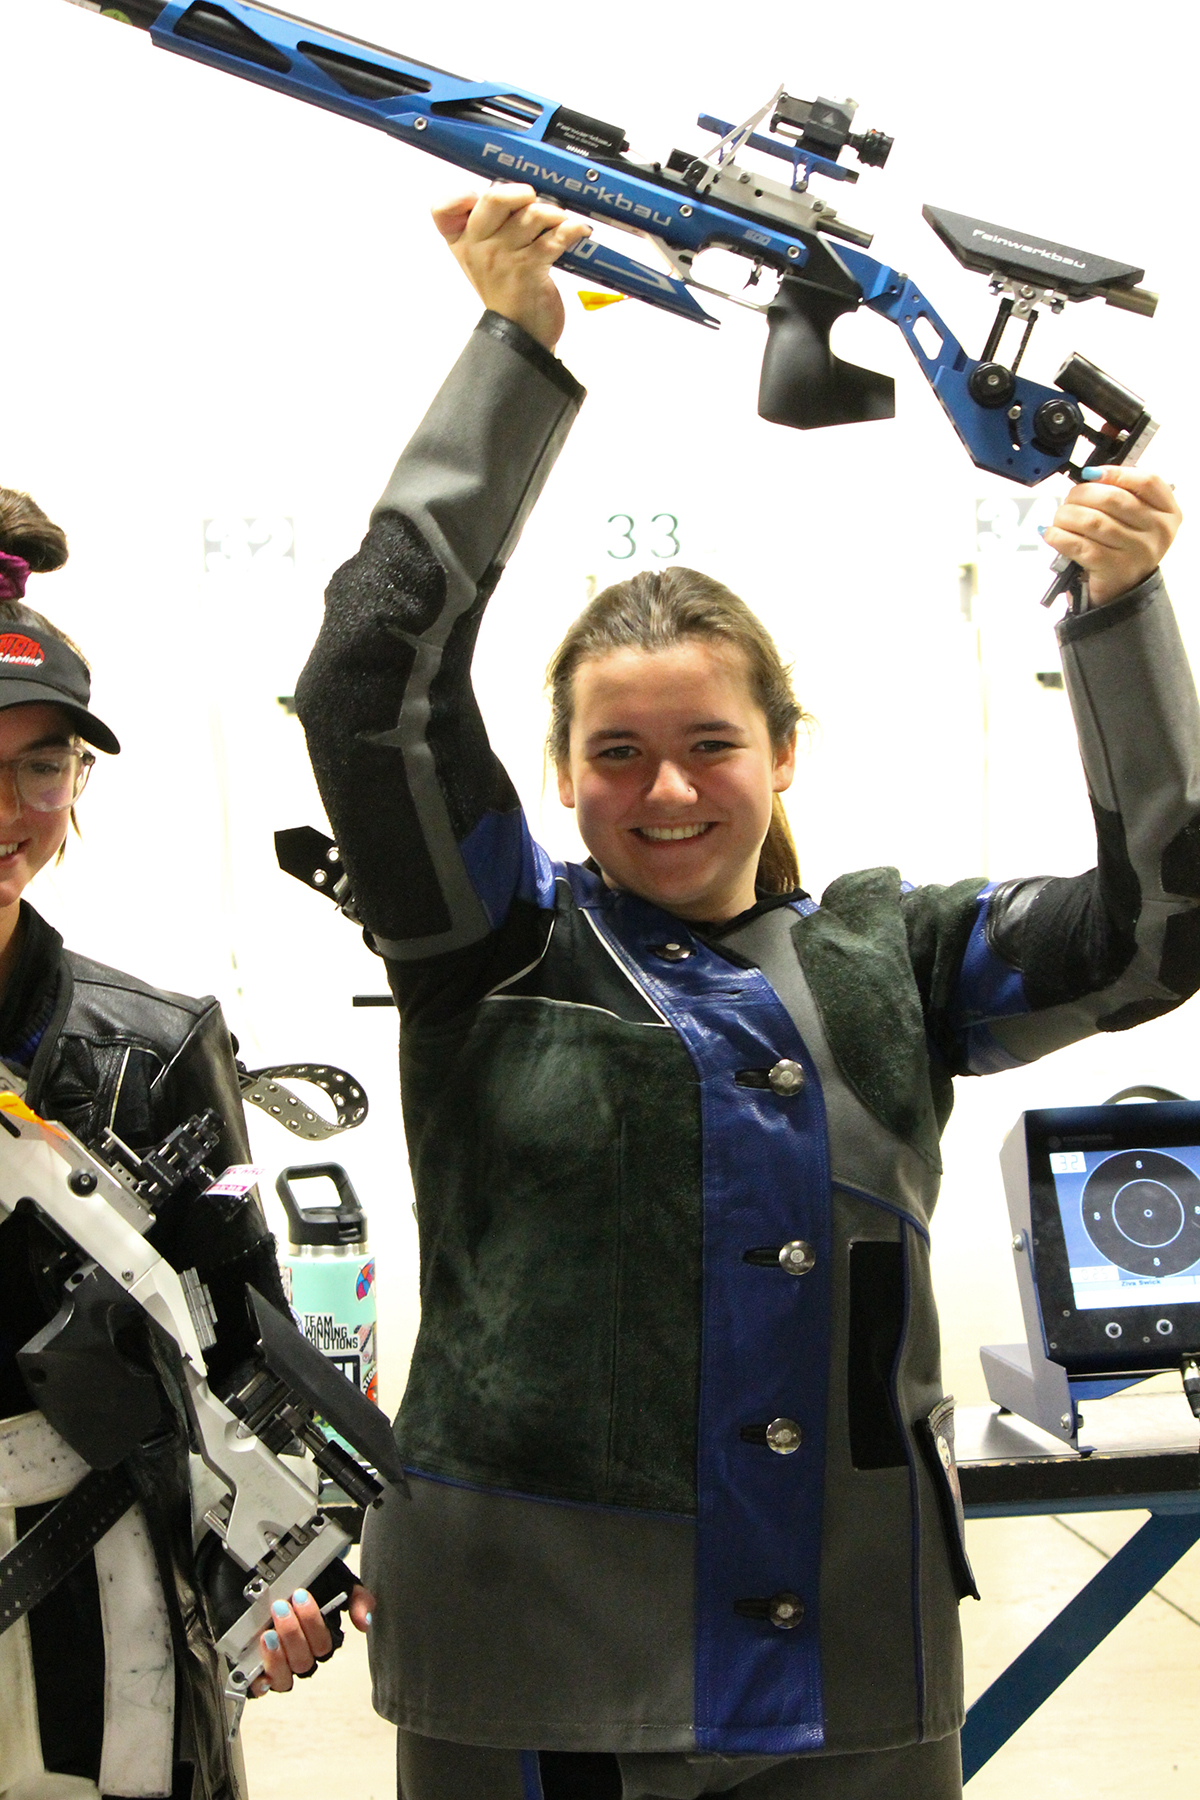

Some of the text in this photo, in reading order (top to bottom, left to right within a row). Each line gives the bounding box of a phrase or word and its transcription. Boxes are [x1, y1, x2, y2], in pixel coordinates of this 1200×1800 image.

[482, 142, 672, 227] Feinwerkbau
[972, 228, 1086, 269] Feinwerkbau
[607, 513, 681, 560] 33
[1059, 1154, 1079, 1171] 32
[304, 1315, 333, 1327] TEAM
[304, 1326, 348, 1339] WINNING
[308, 1338, 358, 1350] OLUTIONS
